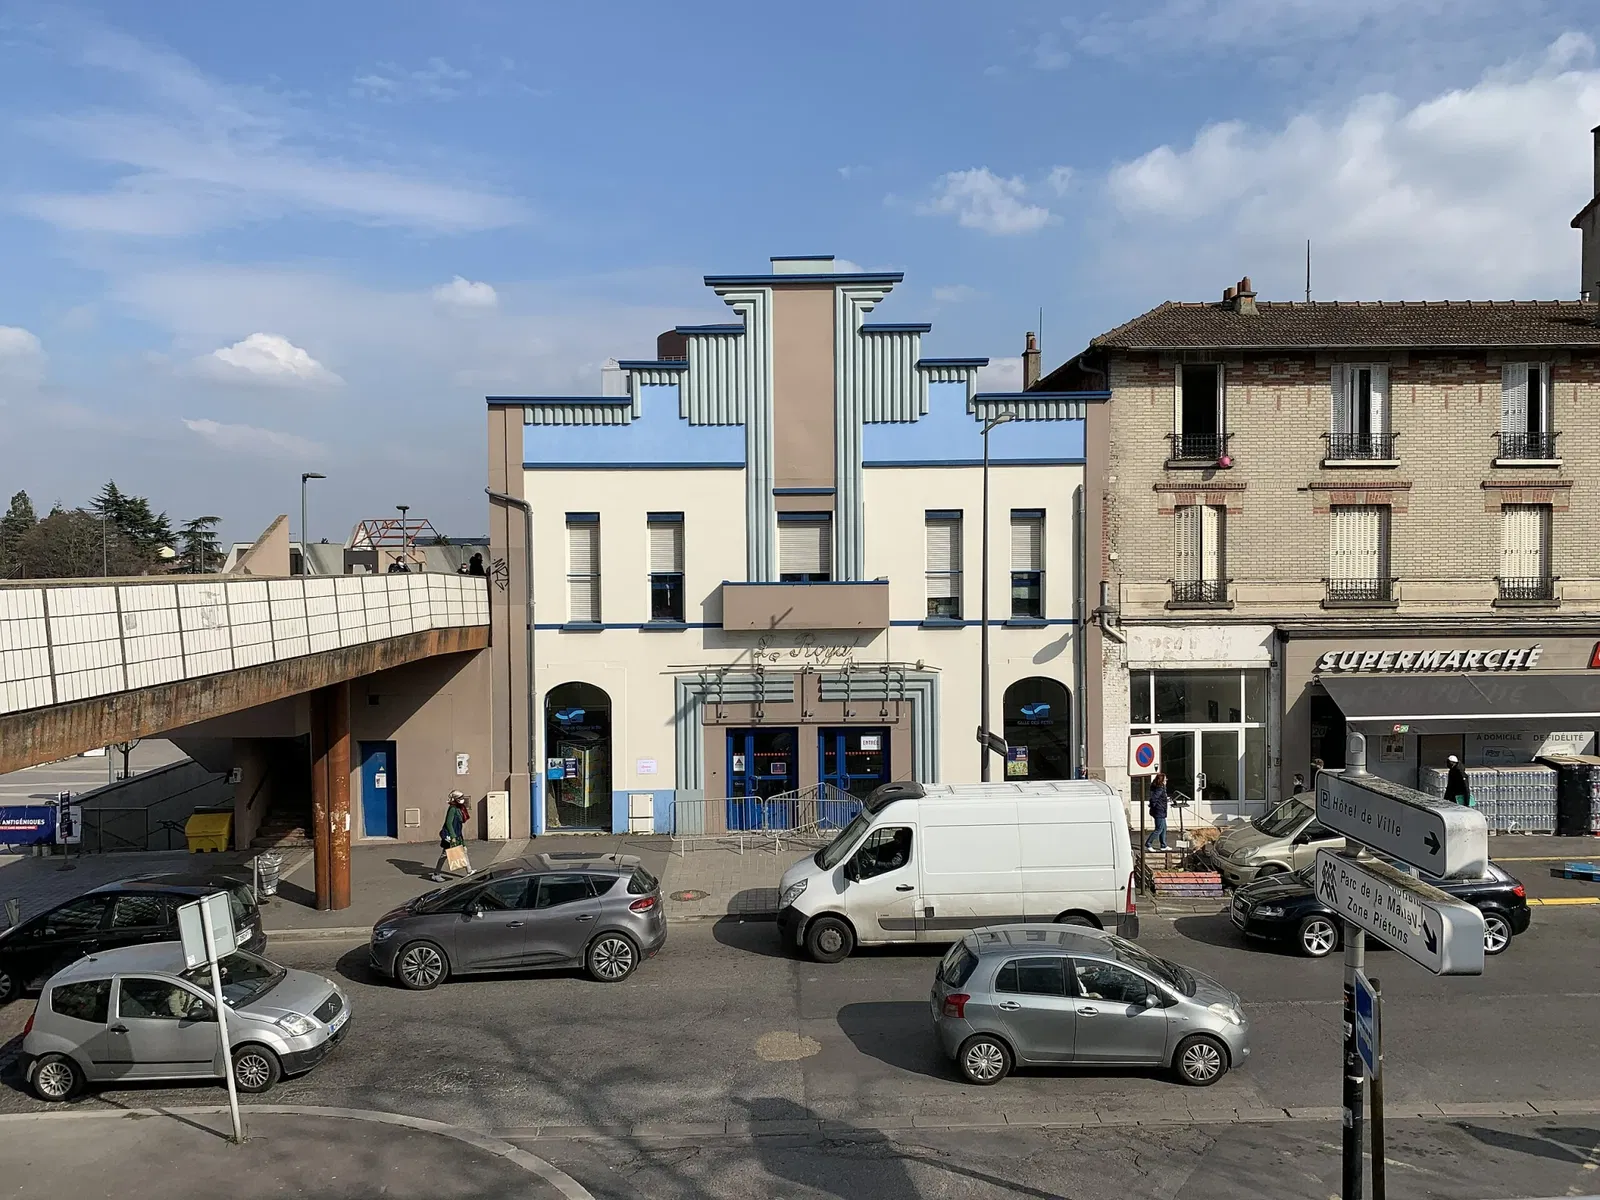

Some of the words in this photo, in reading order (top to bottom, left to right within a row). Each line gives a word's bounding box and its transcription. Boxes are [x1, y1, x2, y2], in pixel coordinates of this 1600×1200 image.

[1318, 644, 1543, 670] SUPERMARCHÉ
[1483, 733, 1523, 741] DOMICILE
[1547, 732, 1584, 741] FIDÉLITÉ
[1333, 796, 1357, 818] Hôtel
[1361, 809, 1372, 824] de
[1377, 813, 1401, 836] Ville
[1340, 870, 1357, 891] Parc
[1361, 882, 1371, 898] de
[1374, 889, 1383, 906] la
[1347, 896, 1369, 920] Zone
[1373, 911, 1409, 944] Piétons
